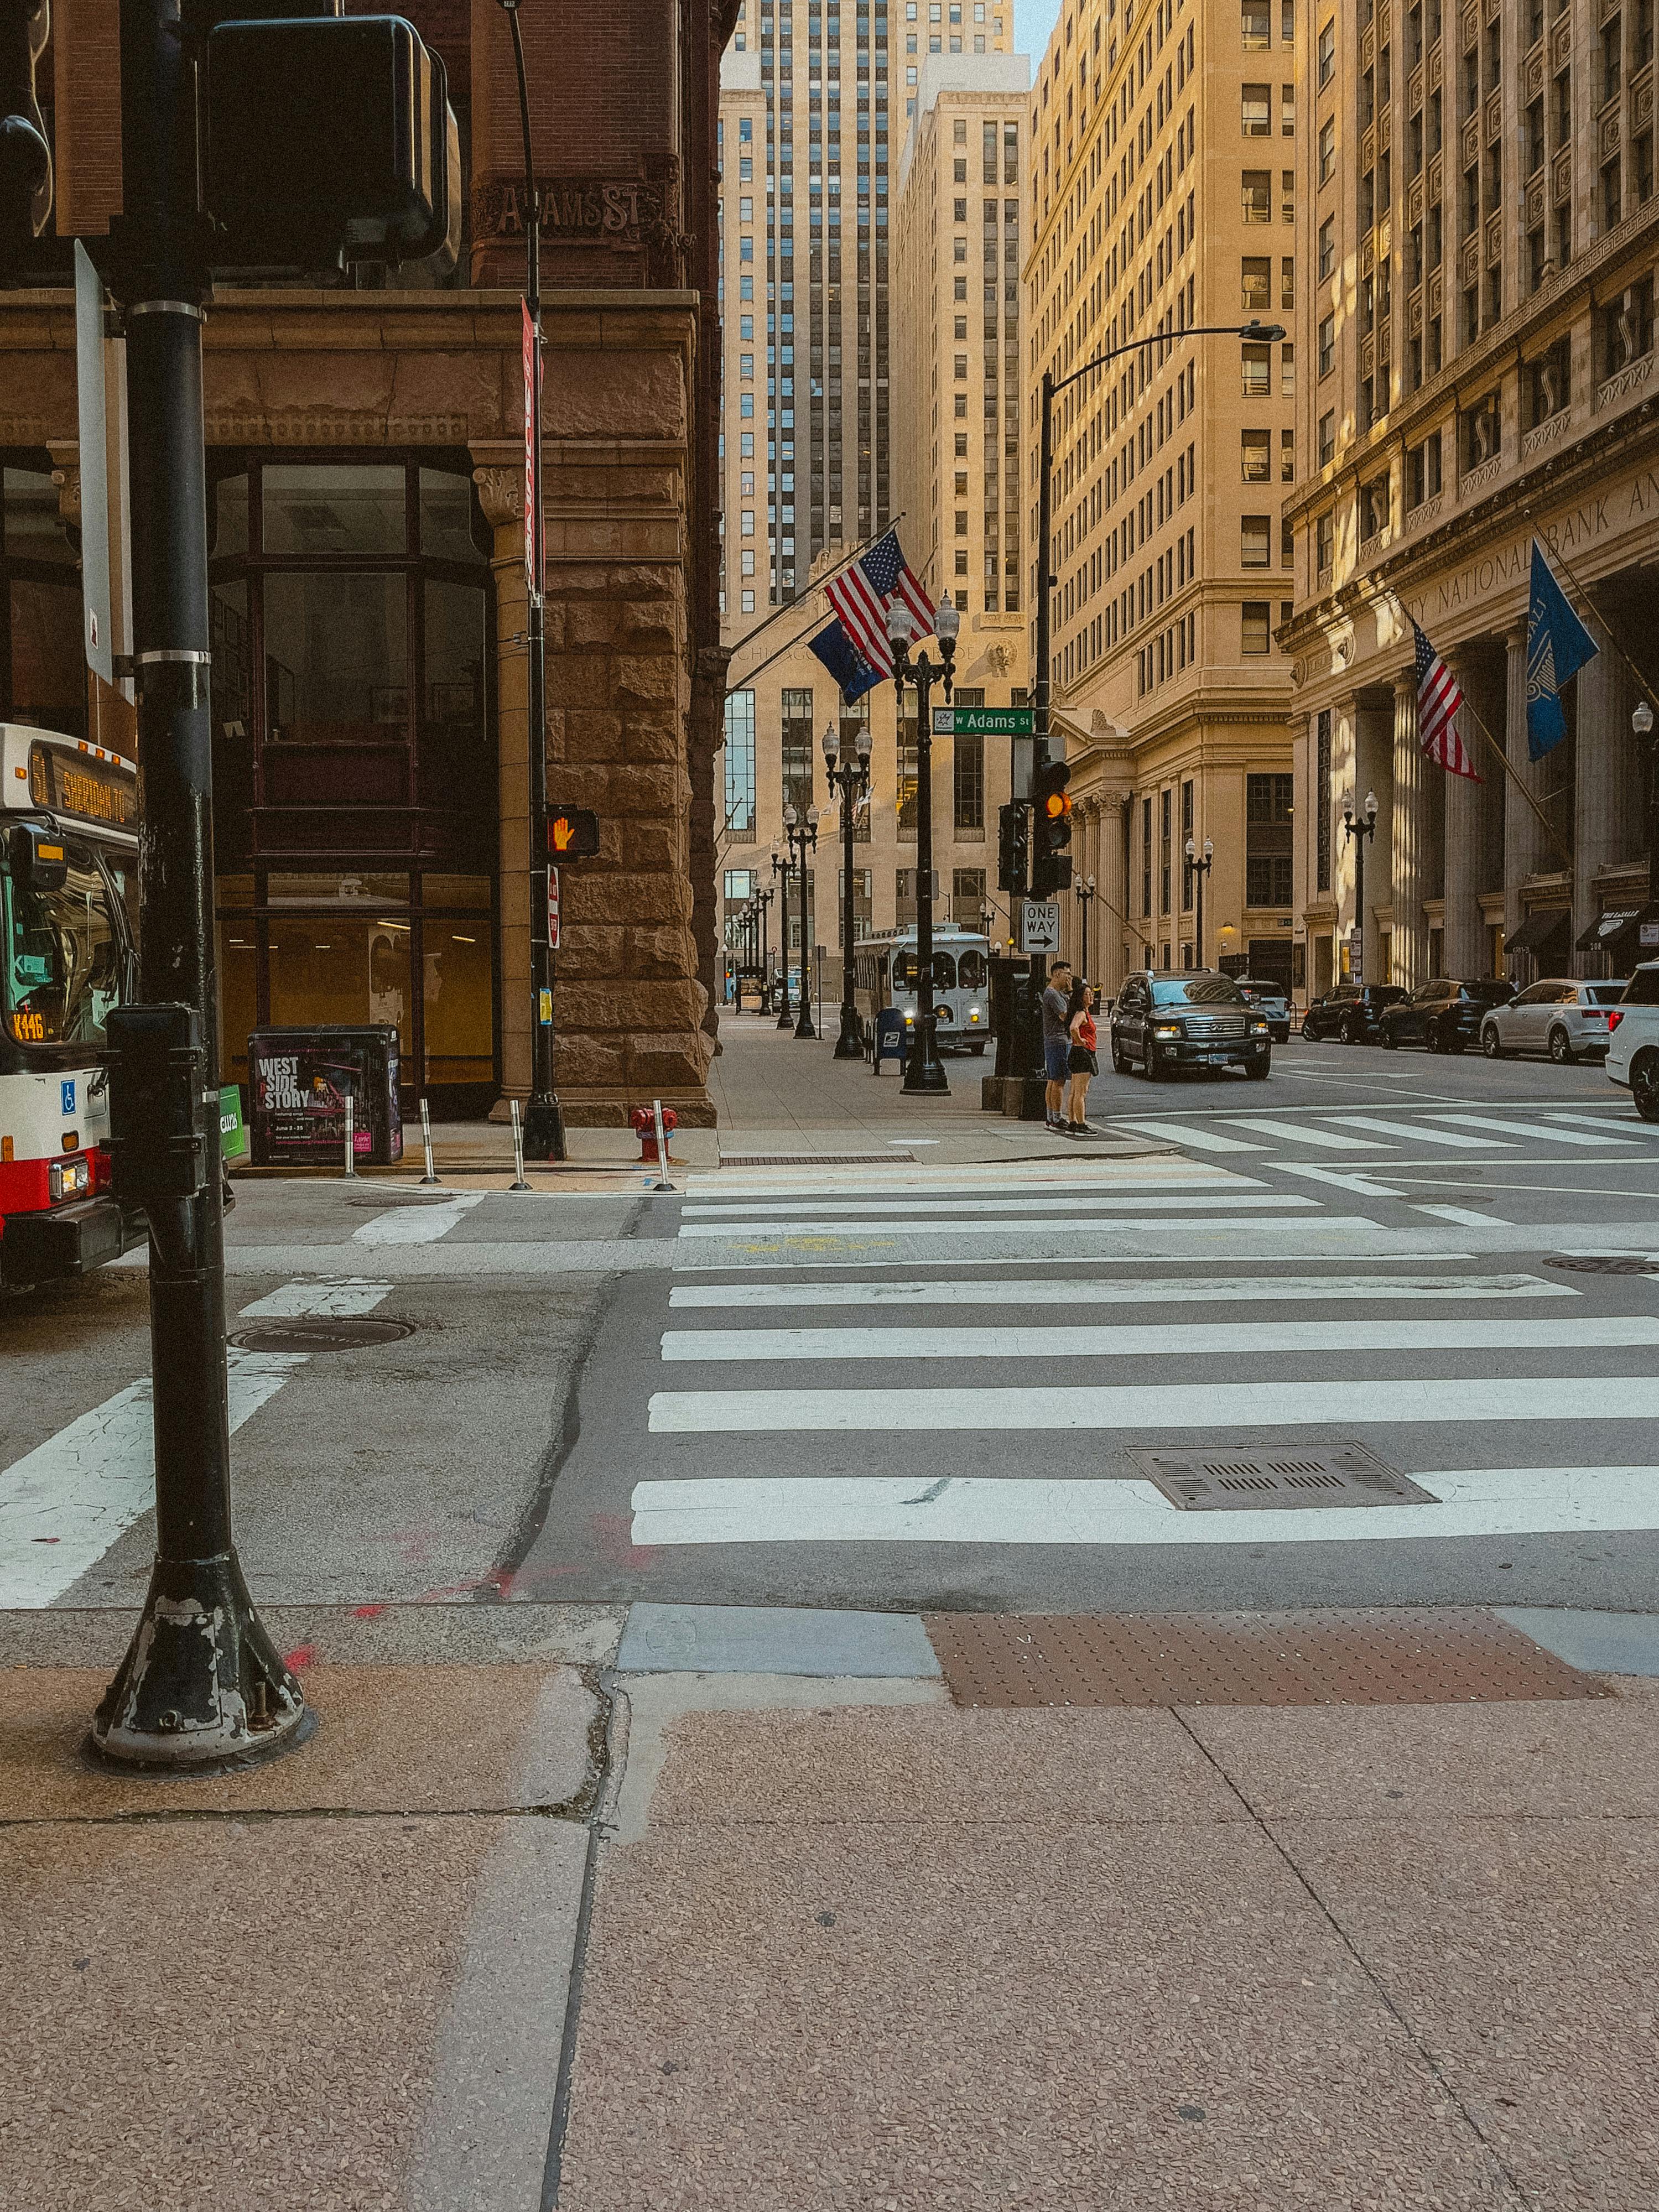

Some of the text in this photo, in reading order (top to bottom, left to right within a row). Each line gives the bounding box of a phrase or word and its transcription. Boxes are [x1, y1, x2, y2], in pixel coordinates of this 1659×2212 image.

[1438, 538, 1531, 613] NATIONAL
[1548, 497, 1609, 558] BANK
[968, 714, 1015, 728] Adams
[63, 771, 112, 820] SHERIDAN
[1028, 907, 1055, 918] ONE
[1027, 921, 1055, 933] WAY
[258, 1057, 298, 1076] WEST
[266, 1075, 298, 1092] SIDE
[264, 1090, 310, 1110] STORY
